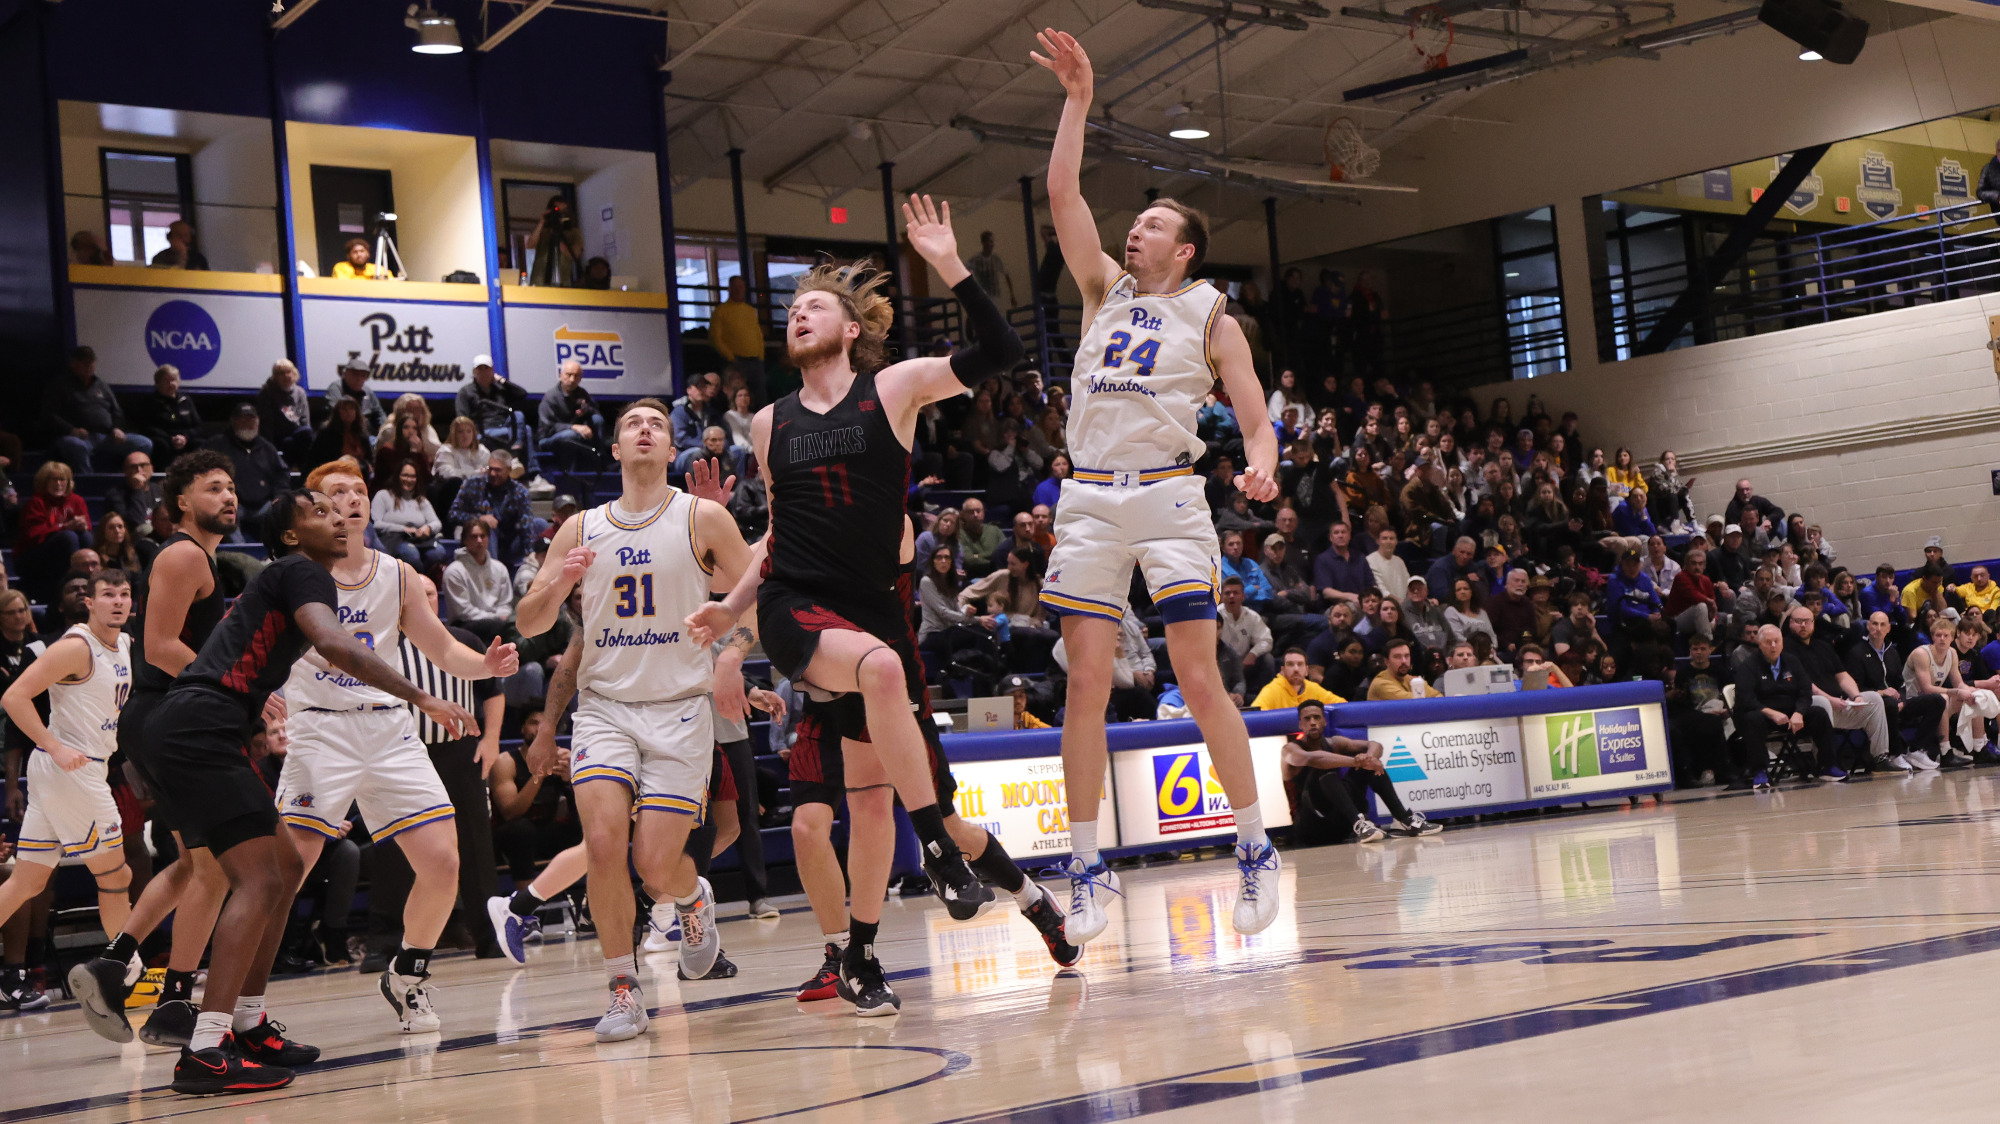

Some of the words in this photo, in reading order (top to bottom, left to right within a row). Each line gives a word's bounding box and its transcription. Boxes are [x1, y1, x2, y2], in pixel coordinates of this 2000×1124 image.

[1130, 307, 1162, 331] Pitt
[151, 330, 212, 350] NCAA
[360, 312, 434, 353] Pitt
[556, 343, 624, 366] PSAC
[1102, 329, 1163, 377] 24
[337, 351, 465, 382] hnstown
[789, 425, 867, 464] HAWKS
[811, 462, 854, 508] 11
[615, 546, 652, 567] Pitt
[613, 571, 657, 619] 31
[338, 606, 368, 624] Pitt
[595, 628, 680, 648] Johnstown
[113, 663, 128, 677] Pitt
[114, 682, 129, 712] 10
[1421, 726, 1500, 751] Conemaugh
[1599, 723, 1628, 736] Holiday
[1627, 721, 1640, 732] Inn
[1600, 735, 1642, 754] Express
[1424, 751, 1469, 771] Health
[1470, 749, 1517, 773] System
[1609, 754, 1615, 763] &
[1615, 752, 1636, 763] Suites
[1158, 754, 1201, 816] 6
[1408, 782, 1492, 802] conemaugh.org
[953, 780, 988, 818] itt
[1038, 807, 1071, 835] CAT
[1160, 822, 1191, 832] JOHNSTOWN
[1193, 819, 1217, 828] ALTOONA
